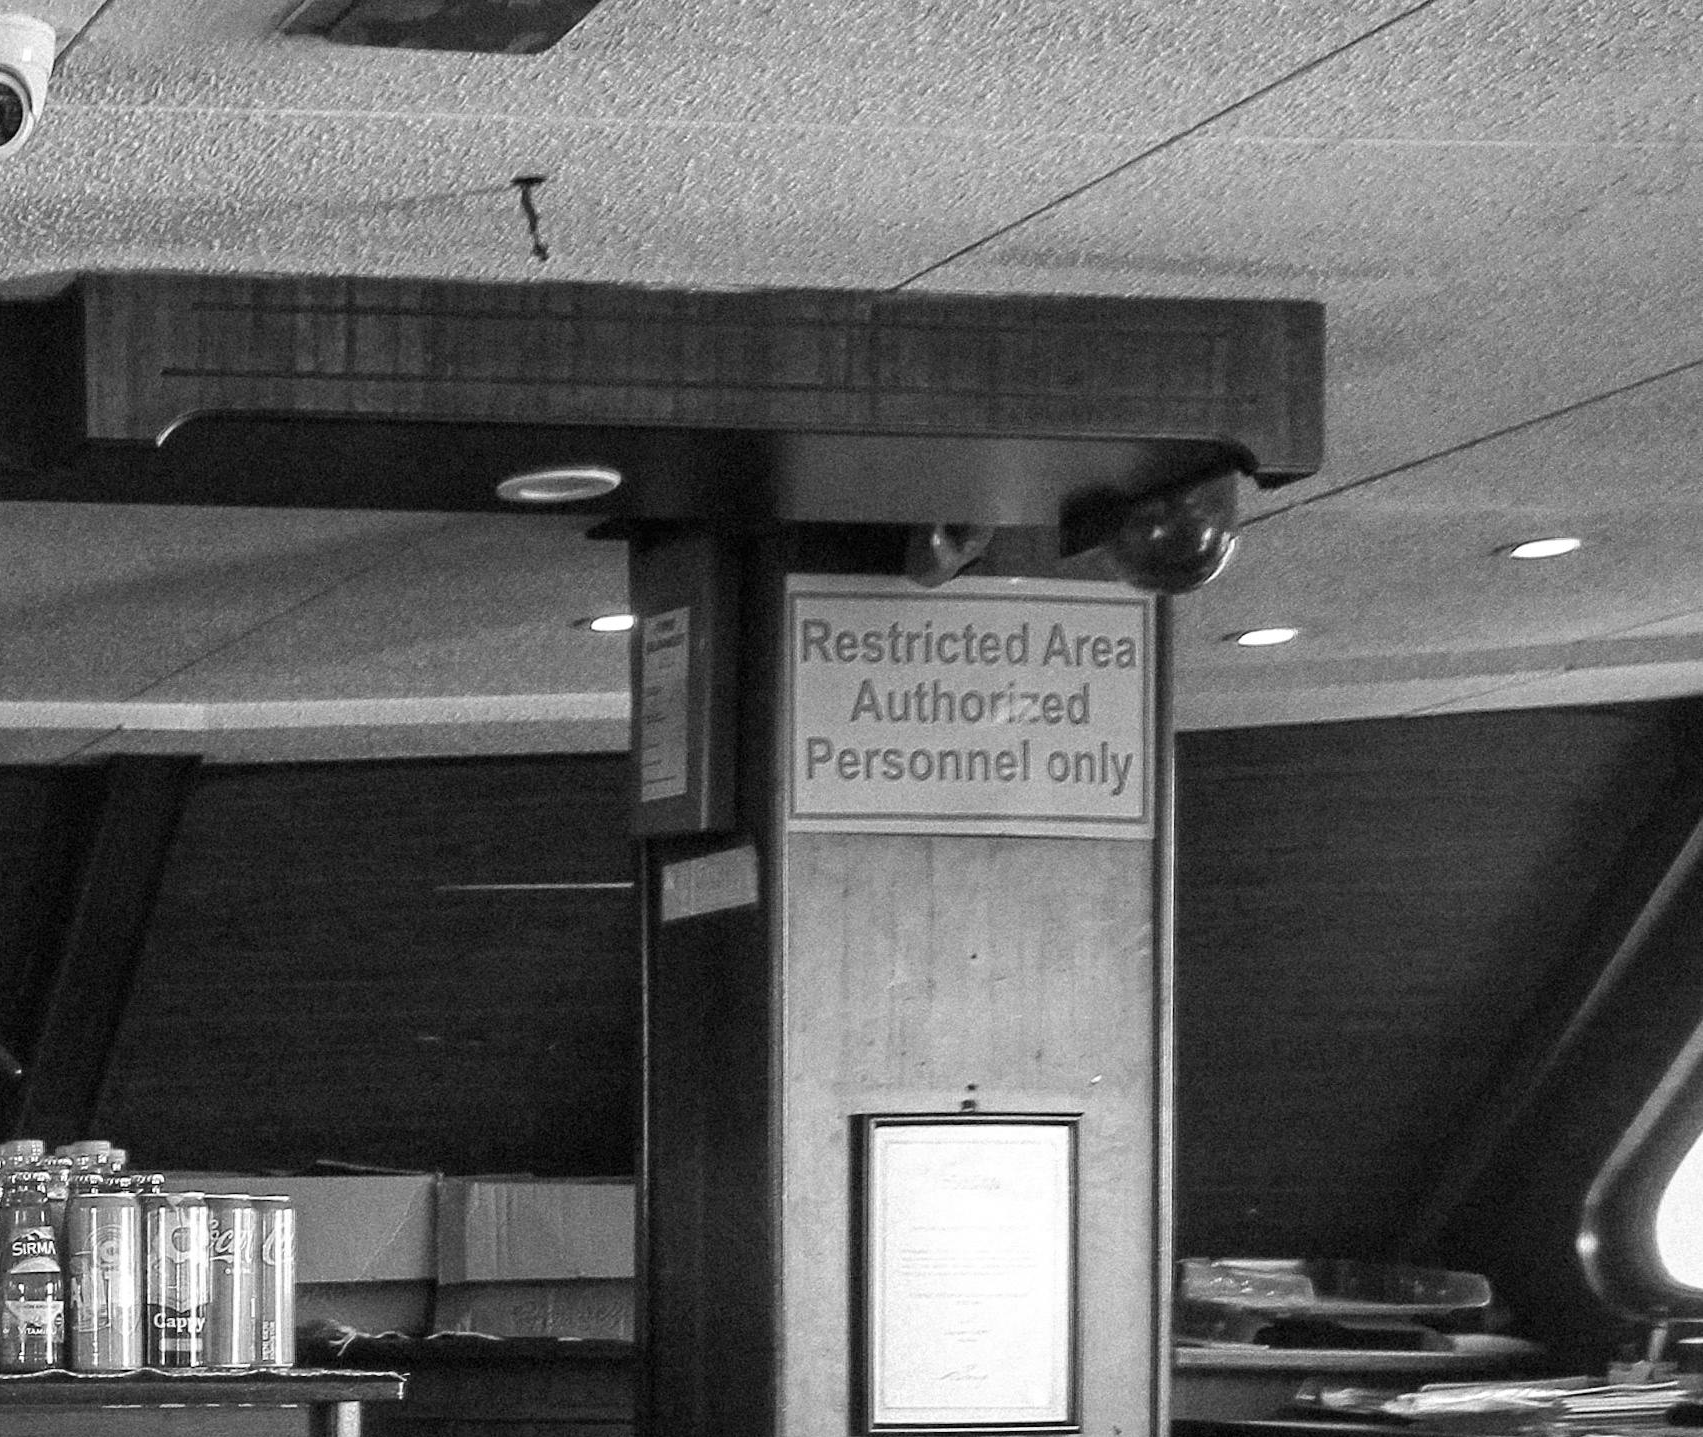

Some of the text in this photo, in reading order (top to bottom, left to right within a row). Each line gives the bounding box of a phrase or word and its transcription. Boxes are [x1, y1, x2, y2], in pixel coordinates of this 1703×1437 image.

[800, 617, 1138, 668] Restricted Area
[849, 677, 1091, 725] Authorized
[805, 736, 1133, 797] Personnel only
